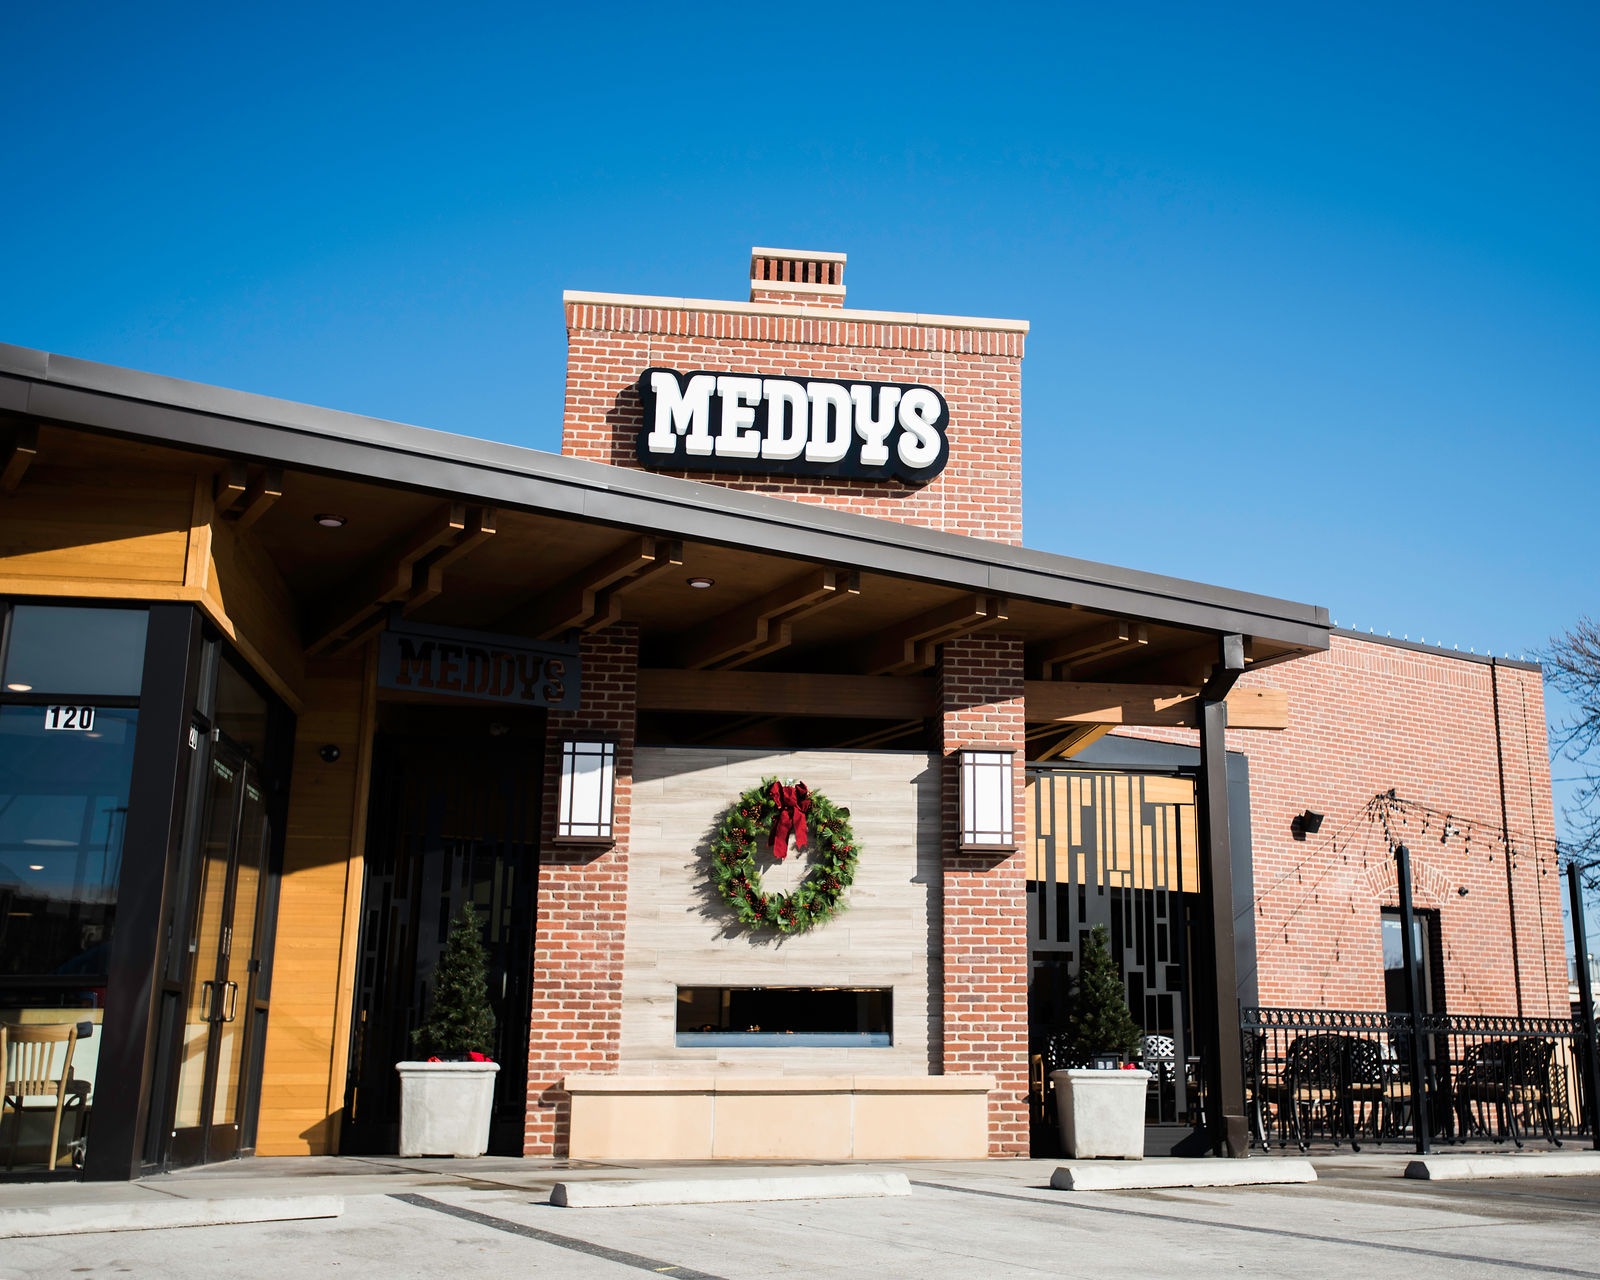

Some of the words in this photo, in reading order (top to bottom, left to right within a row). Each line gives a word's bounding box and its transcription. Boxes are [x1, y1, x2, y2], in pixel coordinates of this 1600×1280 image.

[648, 372, 941, 468] MEDDYS
[396, 638, 566, 703] MEDDYS
[51, 706, 93, 729] 120
